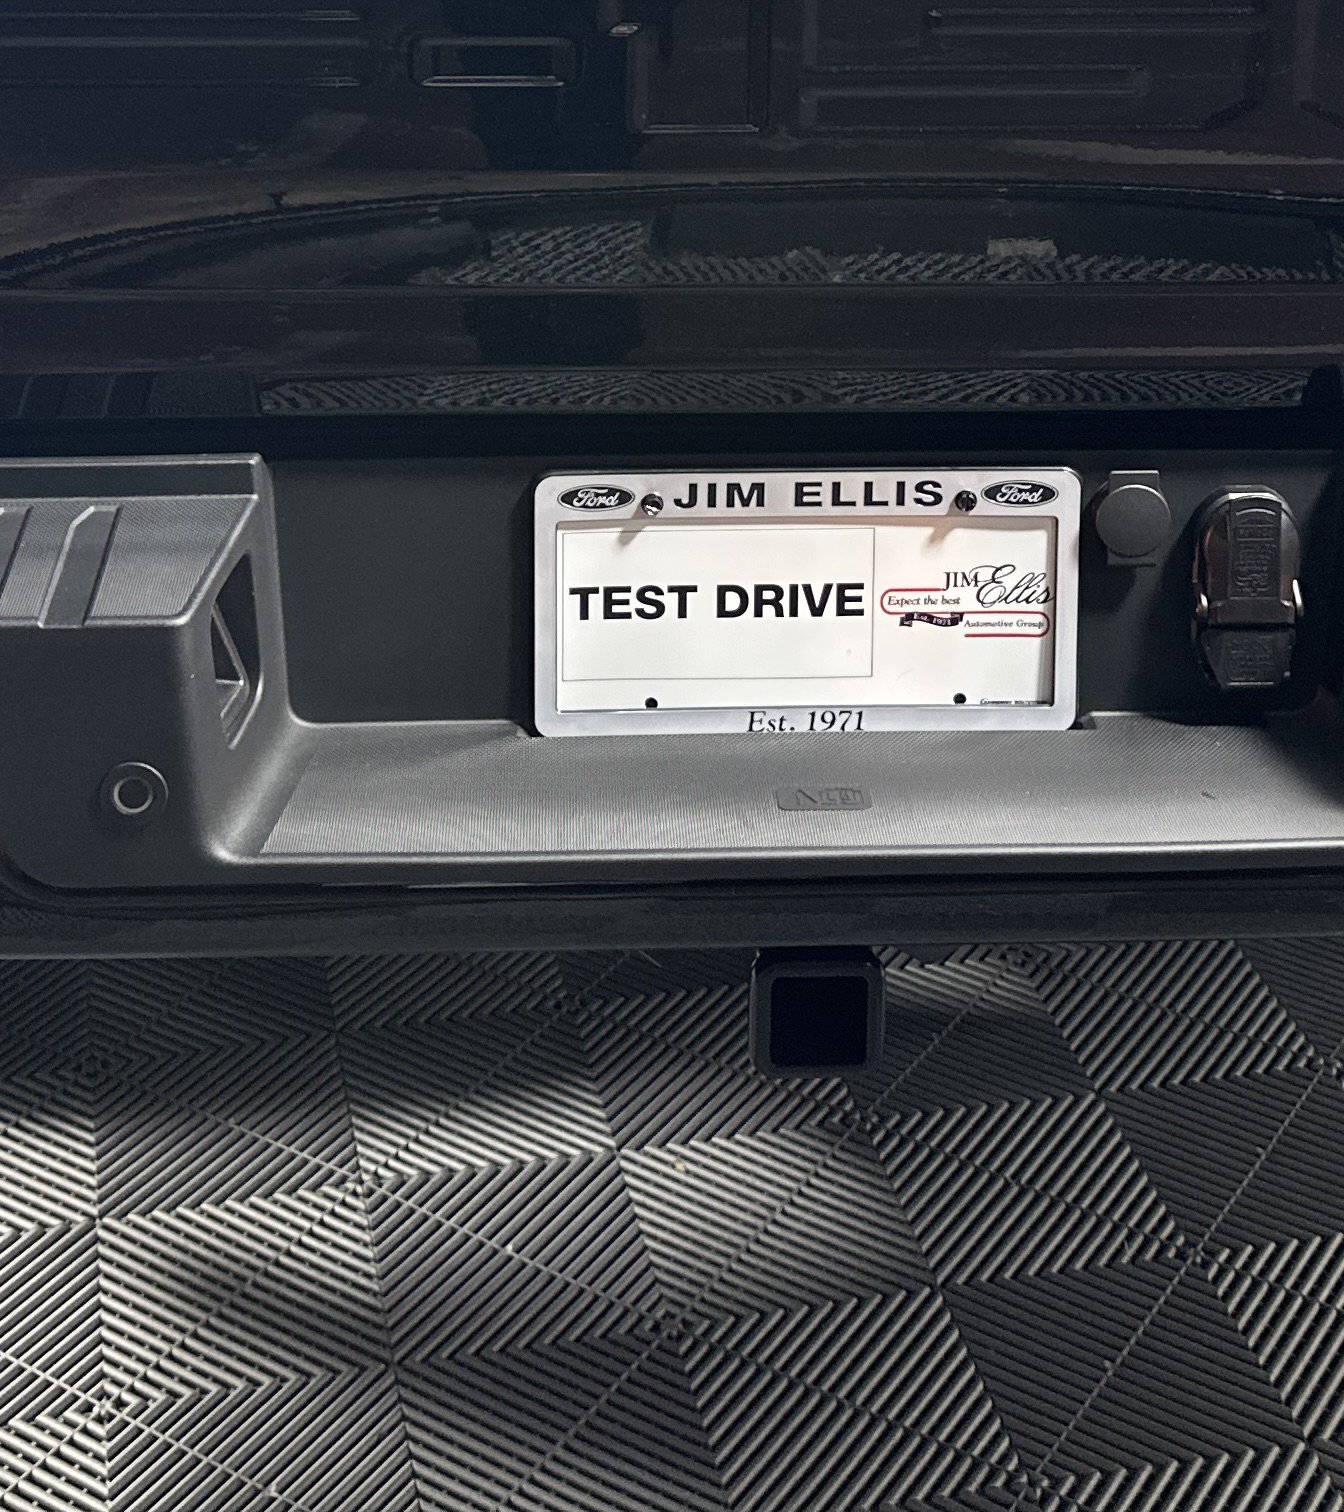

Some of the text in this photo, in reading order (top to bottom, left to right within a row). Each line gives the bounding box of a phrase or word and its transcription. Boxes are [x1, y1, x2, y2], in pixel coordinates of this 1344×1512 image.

[572, 488, 620, 508] Ford
[673, 480, 943, 509] JIM ELLIS
[995, 483, 1042, 504] Ford
[943, 563, 1055, 609] JIM Ellis
[568, 582, 866, 621] TEST DRIVE
[887, 594, 961, 609] Expect the best
[964, 618, 1014, 629] Automotive
[746, 709, 866, 733] Est. 1971
